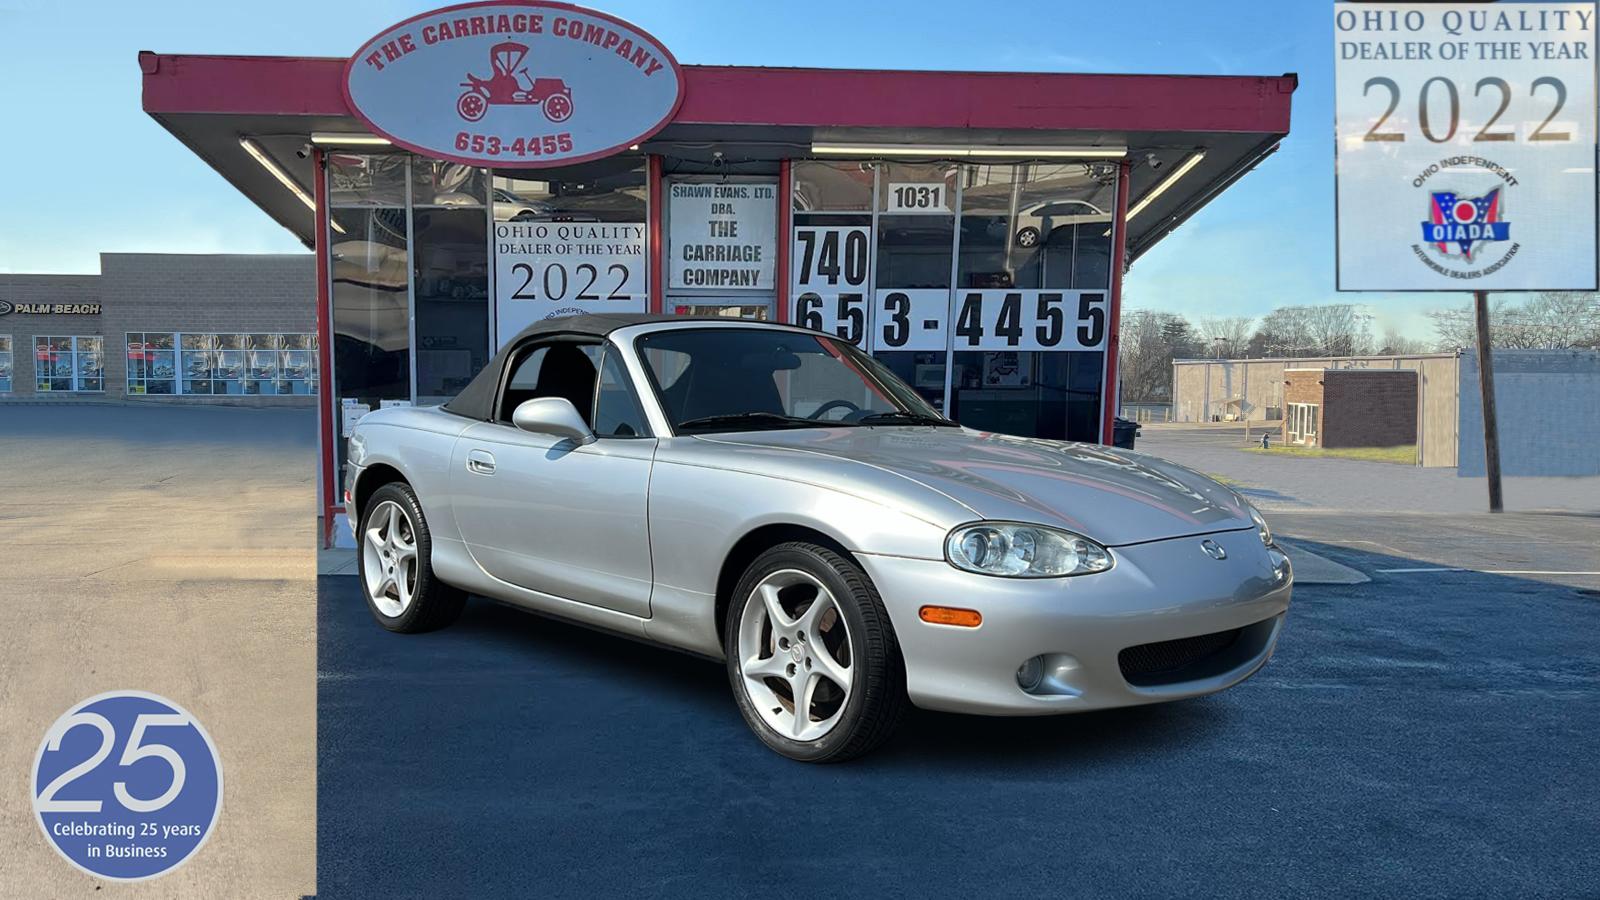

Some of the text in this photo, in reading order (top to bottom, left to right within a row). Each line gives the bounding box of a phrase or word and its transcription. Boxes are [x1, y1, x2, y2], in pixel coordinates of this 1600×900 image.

[1336, 10, 1592, 36] OHIO QUALITY
[366, 14, 664, 77] THE CARRIAGE COMPANY
[1340, 41, 1589, 60] DEALER OF THE YEAR
[1362, 76, 1571, 143] 2022
[454, 132, 573, 156] 653-4455
[1412, 155, 1519, 188] OHIO INDEPENDENT
[672, 186, 711, 199] SHAWN
[754, 187, 774, 200] LTD.
[894, 186, 940, 208] 1031
[496, 225, 644, 242] OHIO QUALITY
[708, 220, 738, 238] THE
[1432, 225, 1495, 241] OIADA
[499, 243, 641, 255] DEALER OF THE YEAR
[682, 244, 762, 263] CARRIAGE
[797, 230, 868, 286] 740
[511, 263, 632, 301] 2022
[683, 268, 760, 286] COMPANY
[1449, 270, 1482, 280] DEALERS
[15, 303, 50, 314] PALM
[54, 303, 100, 315] BEACH
